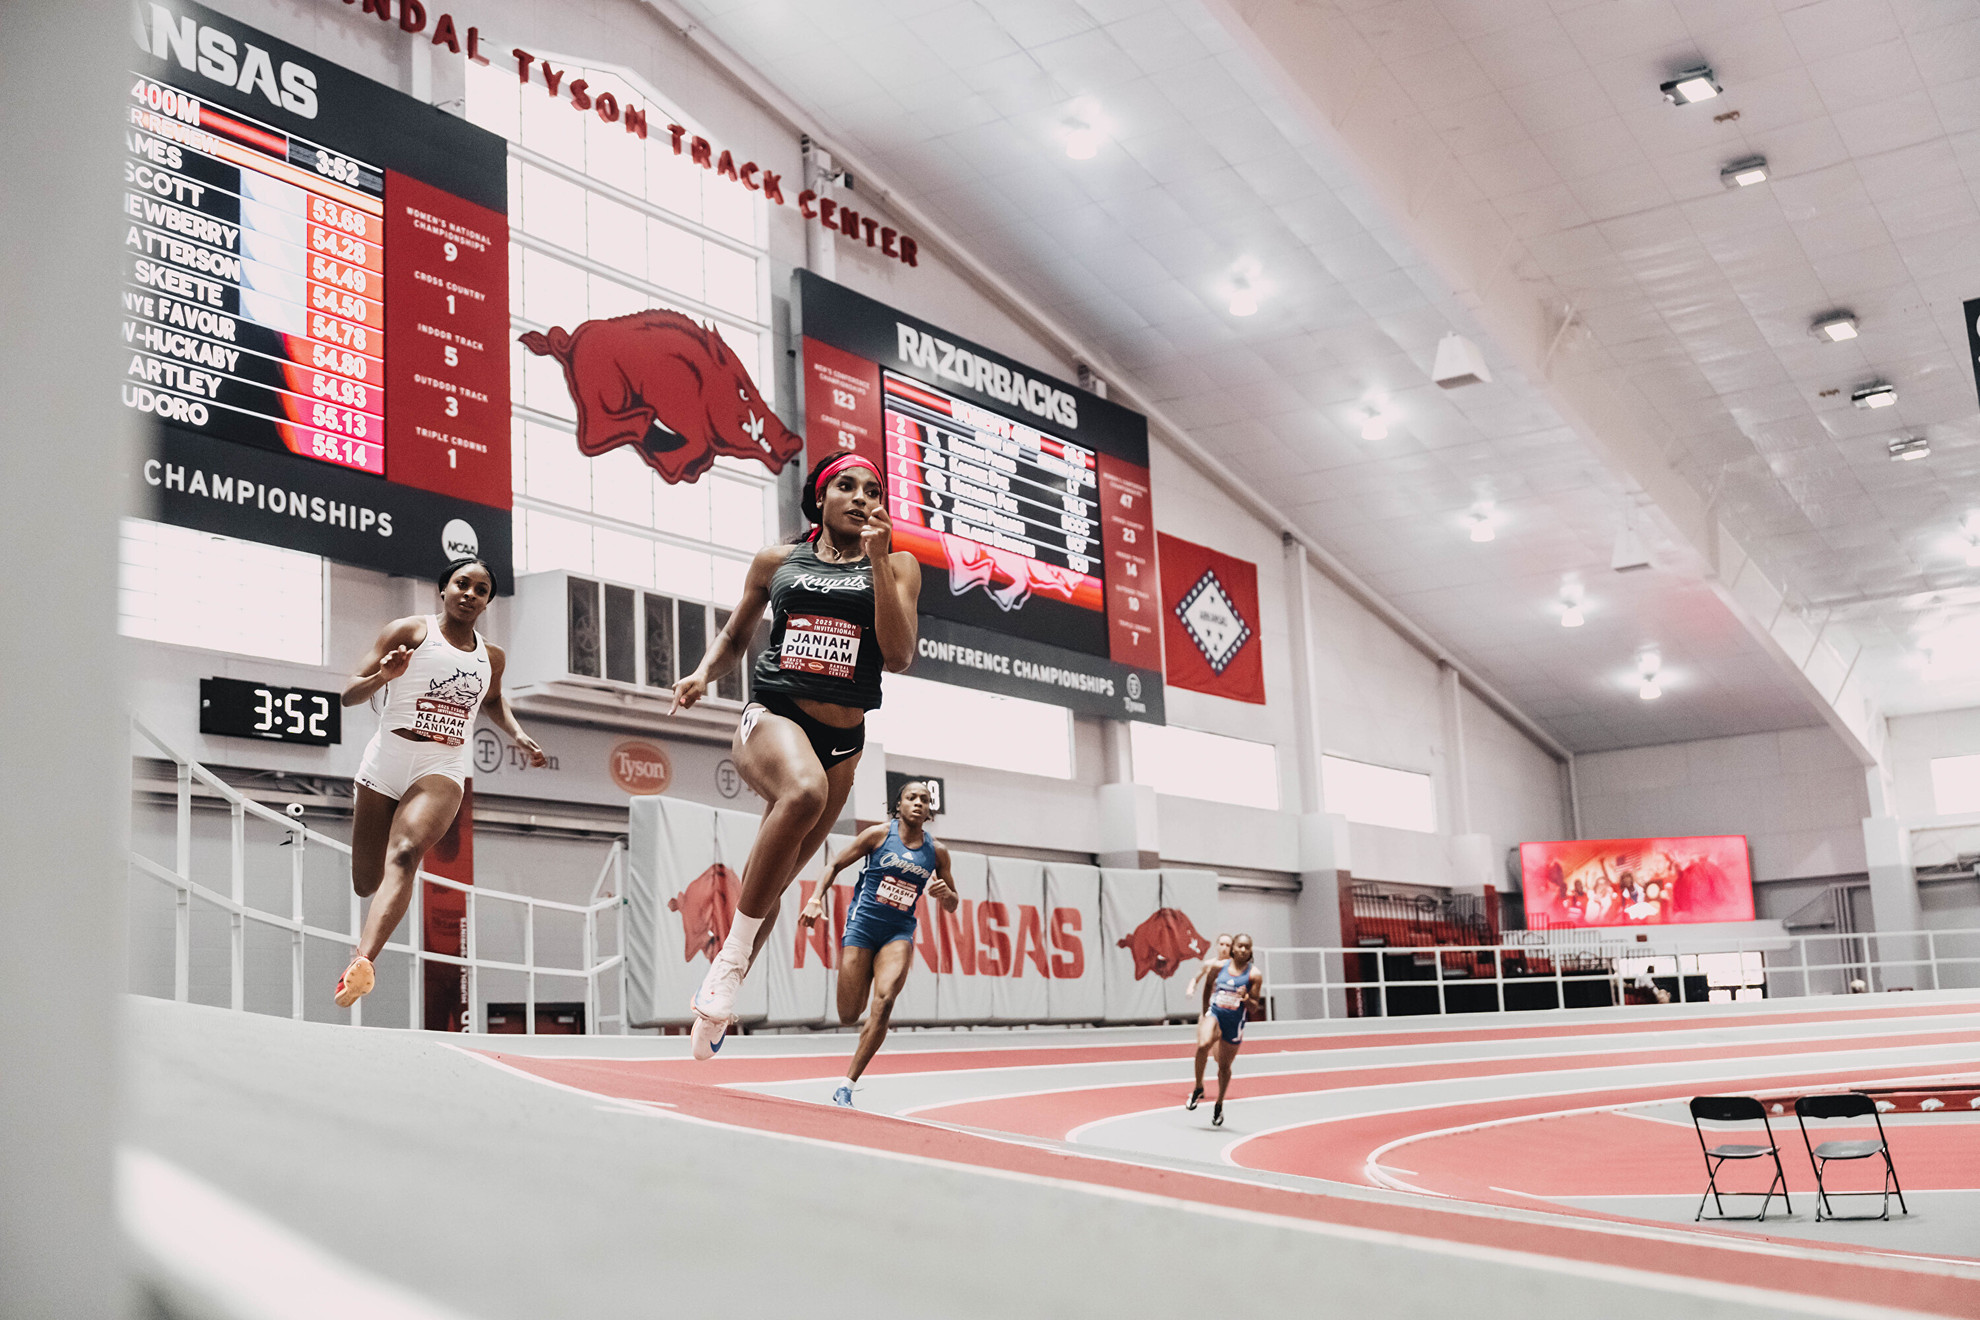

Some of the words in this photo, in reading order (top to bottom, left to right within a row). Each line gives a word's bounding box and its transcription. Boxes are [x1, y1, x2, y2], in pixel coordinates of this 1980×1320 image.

[131, 79, 200, 126] 400M
[149, 113, 220, 155] REVIEW
[342, 0, 490, 67] NDAL
[512, 48, 648, 140] TYSON
[667, 123, 784, 205] TRACK
[798, 189, 918, 268] CENTER
[316, 150, 360, 187] 3:52
[313, 199, 366, 236] 53.68
[406, 206, 447, 228] WOMEN'S
[449, 222, 492, 246] NATIONAL
[313, 227, 366, 265] 54.28
[413, 219, 485, 252] CHAMPIONSHIPS
[443, 242, 458, 262] 9
[313, 256, 366, 293] 54.49
[413, 270, 443, 287] CROSS
[446, 281, 486, 302] COUNTRY
[135, 260, 224, 307] SKEETE
[312, 314, 367, 351] 54.78
[312, 286, 367, 322] 54.50
[446, 294, 455, 315] 1
[158, 297, 236, 341] FAVOUR
[312, 344, 367, 380] 54.80
[417, 323, 452, 340] INDOOR
[455, 334, 484, 352] TRACK
[444, 345, 459, 367] 5
[413, 373, 457, 394] OUTDOOR
[459, 386, 489, 403] TRACK
[896, 321, 1078, 429] RAZORBACKS
[312, 373, 367, 409] 54.93
[832, 388, 856, 411] 123
[312, 403, 367, 438] 55.13
[445, 395, 459, 418] 3
[896, 415, 905, 434] 2
[312, 433, 367, 467] 55.14
[415, 426, 449, 443] TRIPLE
[450, 436, 488, 454] CROWNS
[838, 430, 856, 450] 53
[447, 448, 457, 469] 1
[143, 458, 394, 538] CHAMPIONSHIPS
[447, 540, 477, 557] NCAA
[1122, 527, 1136, 544] 23
[790, 573, 870, 594] Knights
[813, 625, 856, 636] INVITATIONAL
[815, 618, 833, 626] 2025
[835, 621, 857, 630] TYSON
[1131, 631, 1139, 646] 7
[785, 644, 852, 664] PULLIAM
[792, 633, 850, 650] JANIAH
[918, 638, 1010, 676] CONFERENCE
[1013, 659, 1115, 697] CHAMPIONSHIPS
[254, 689, 329, 737] 3:52
[417, 711, 465, 728] KELAIAH
[415, 720, 463, 737] DANIYAN
[506, 744, 560, 771] Tyn
[617, 752, 665, 782] Tyson
[881, 883, 914, 899] NATASHA
[889, 893, 903, 901] FOX
[793, 880, 1084, 979] AANSAS
